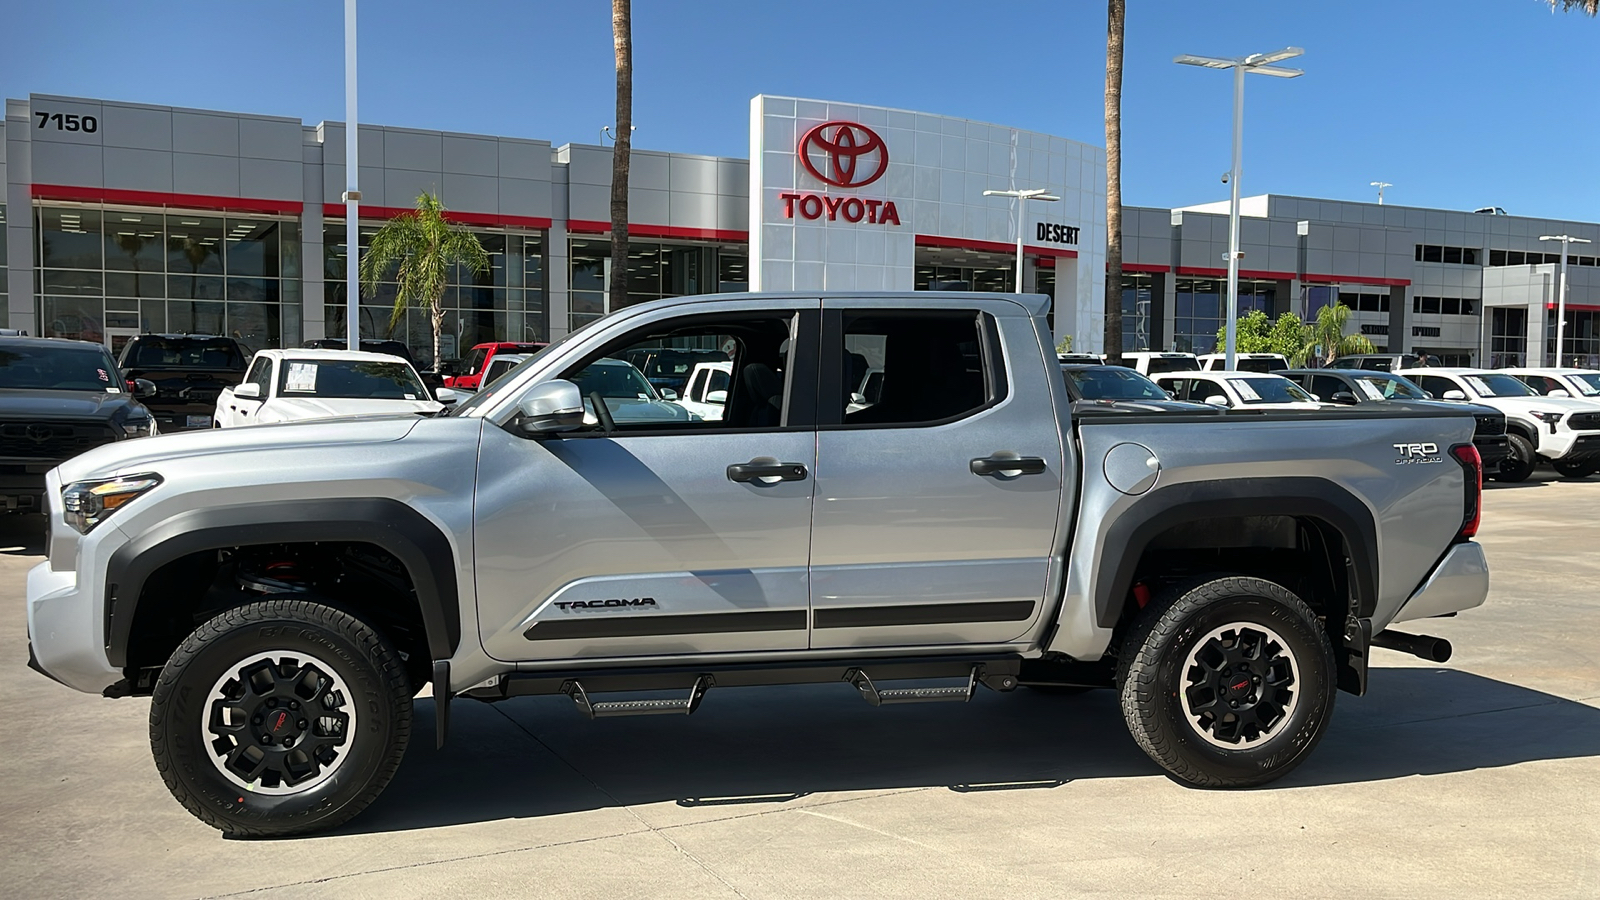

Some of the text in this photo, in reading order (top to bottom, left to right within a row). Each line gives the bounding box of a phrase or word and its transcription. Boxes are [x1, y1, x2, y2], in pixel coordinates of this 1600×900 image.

[35, 111, 97, 133] 7150
[780, 193, 901, 226] TOYOTA
[1036, 222, 1080, 245] DESERT
[1392, 442, 1438, 458] TRD
[553, 597, 656, 611] TACOMA
[1231, 680, 1249, 690] TRD
